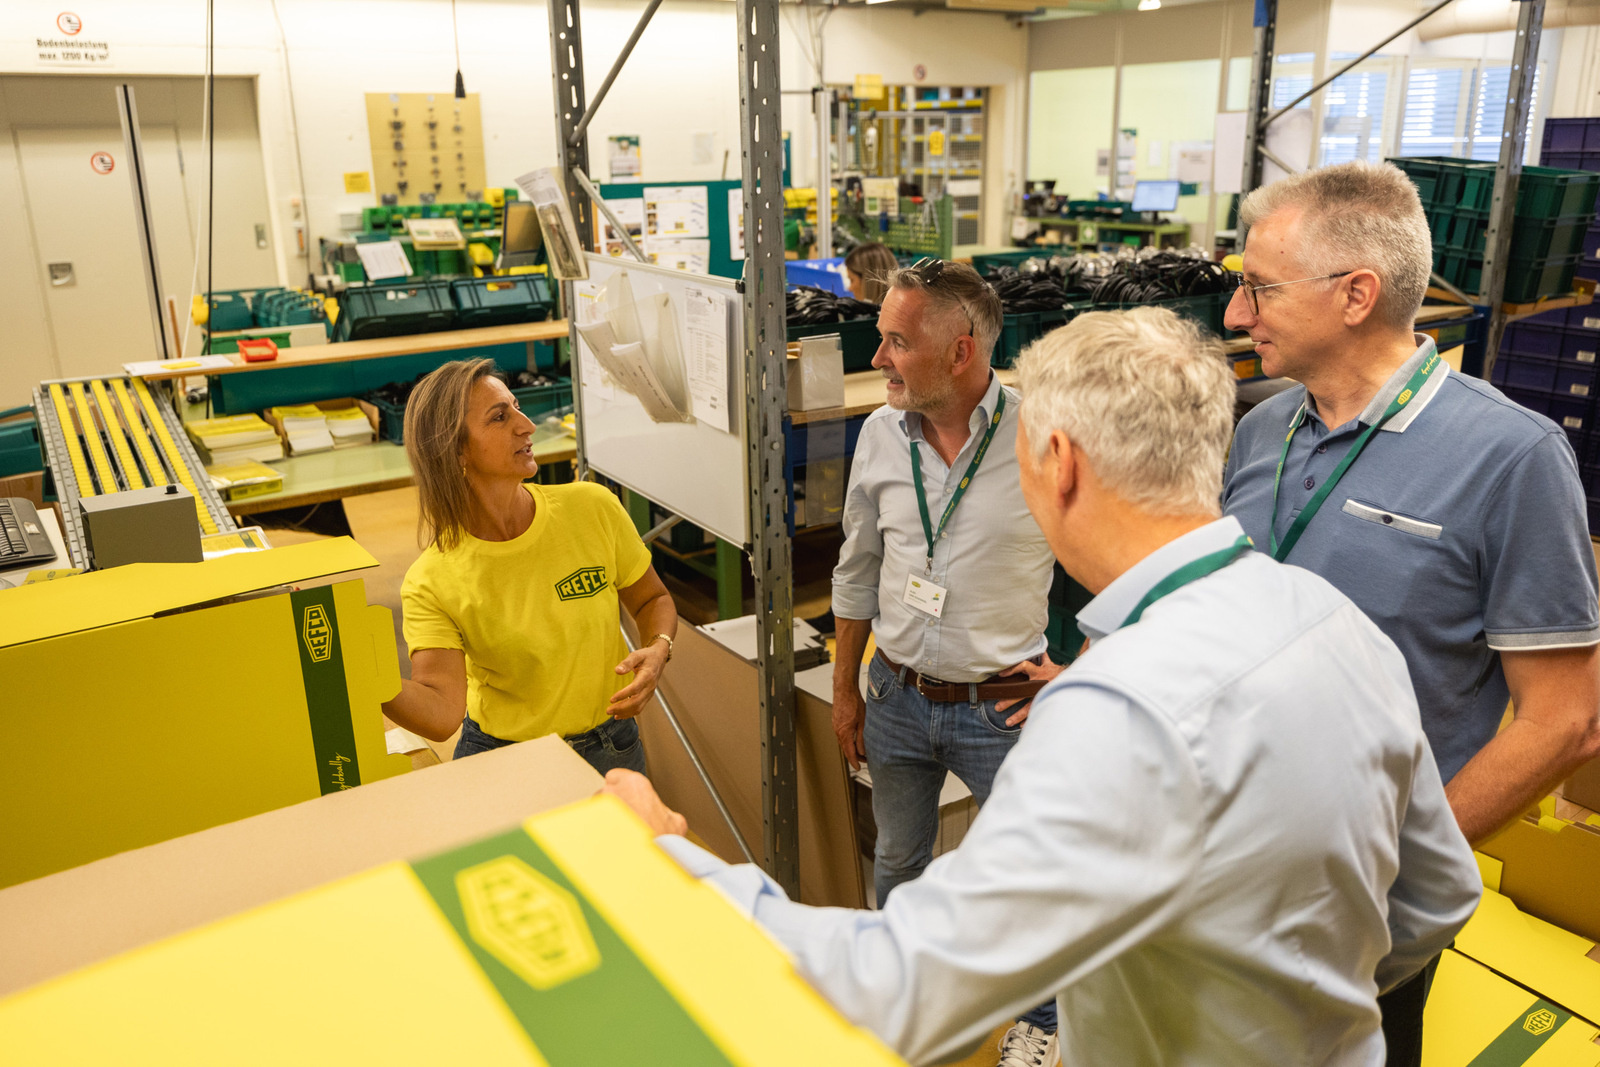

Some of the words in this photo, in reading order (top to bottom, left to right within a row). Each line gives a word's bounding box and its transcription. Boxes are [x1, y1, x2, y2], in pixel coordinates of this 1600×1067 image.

[558, 569, 608, 598] REFCO
[306, 607, 330, 660] REFCO
[1525, 1010, 1554, 1034] REFCO
